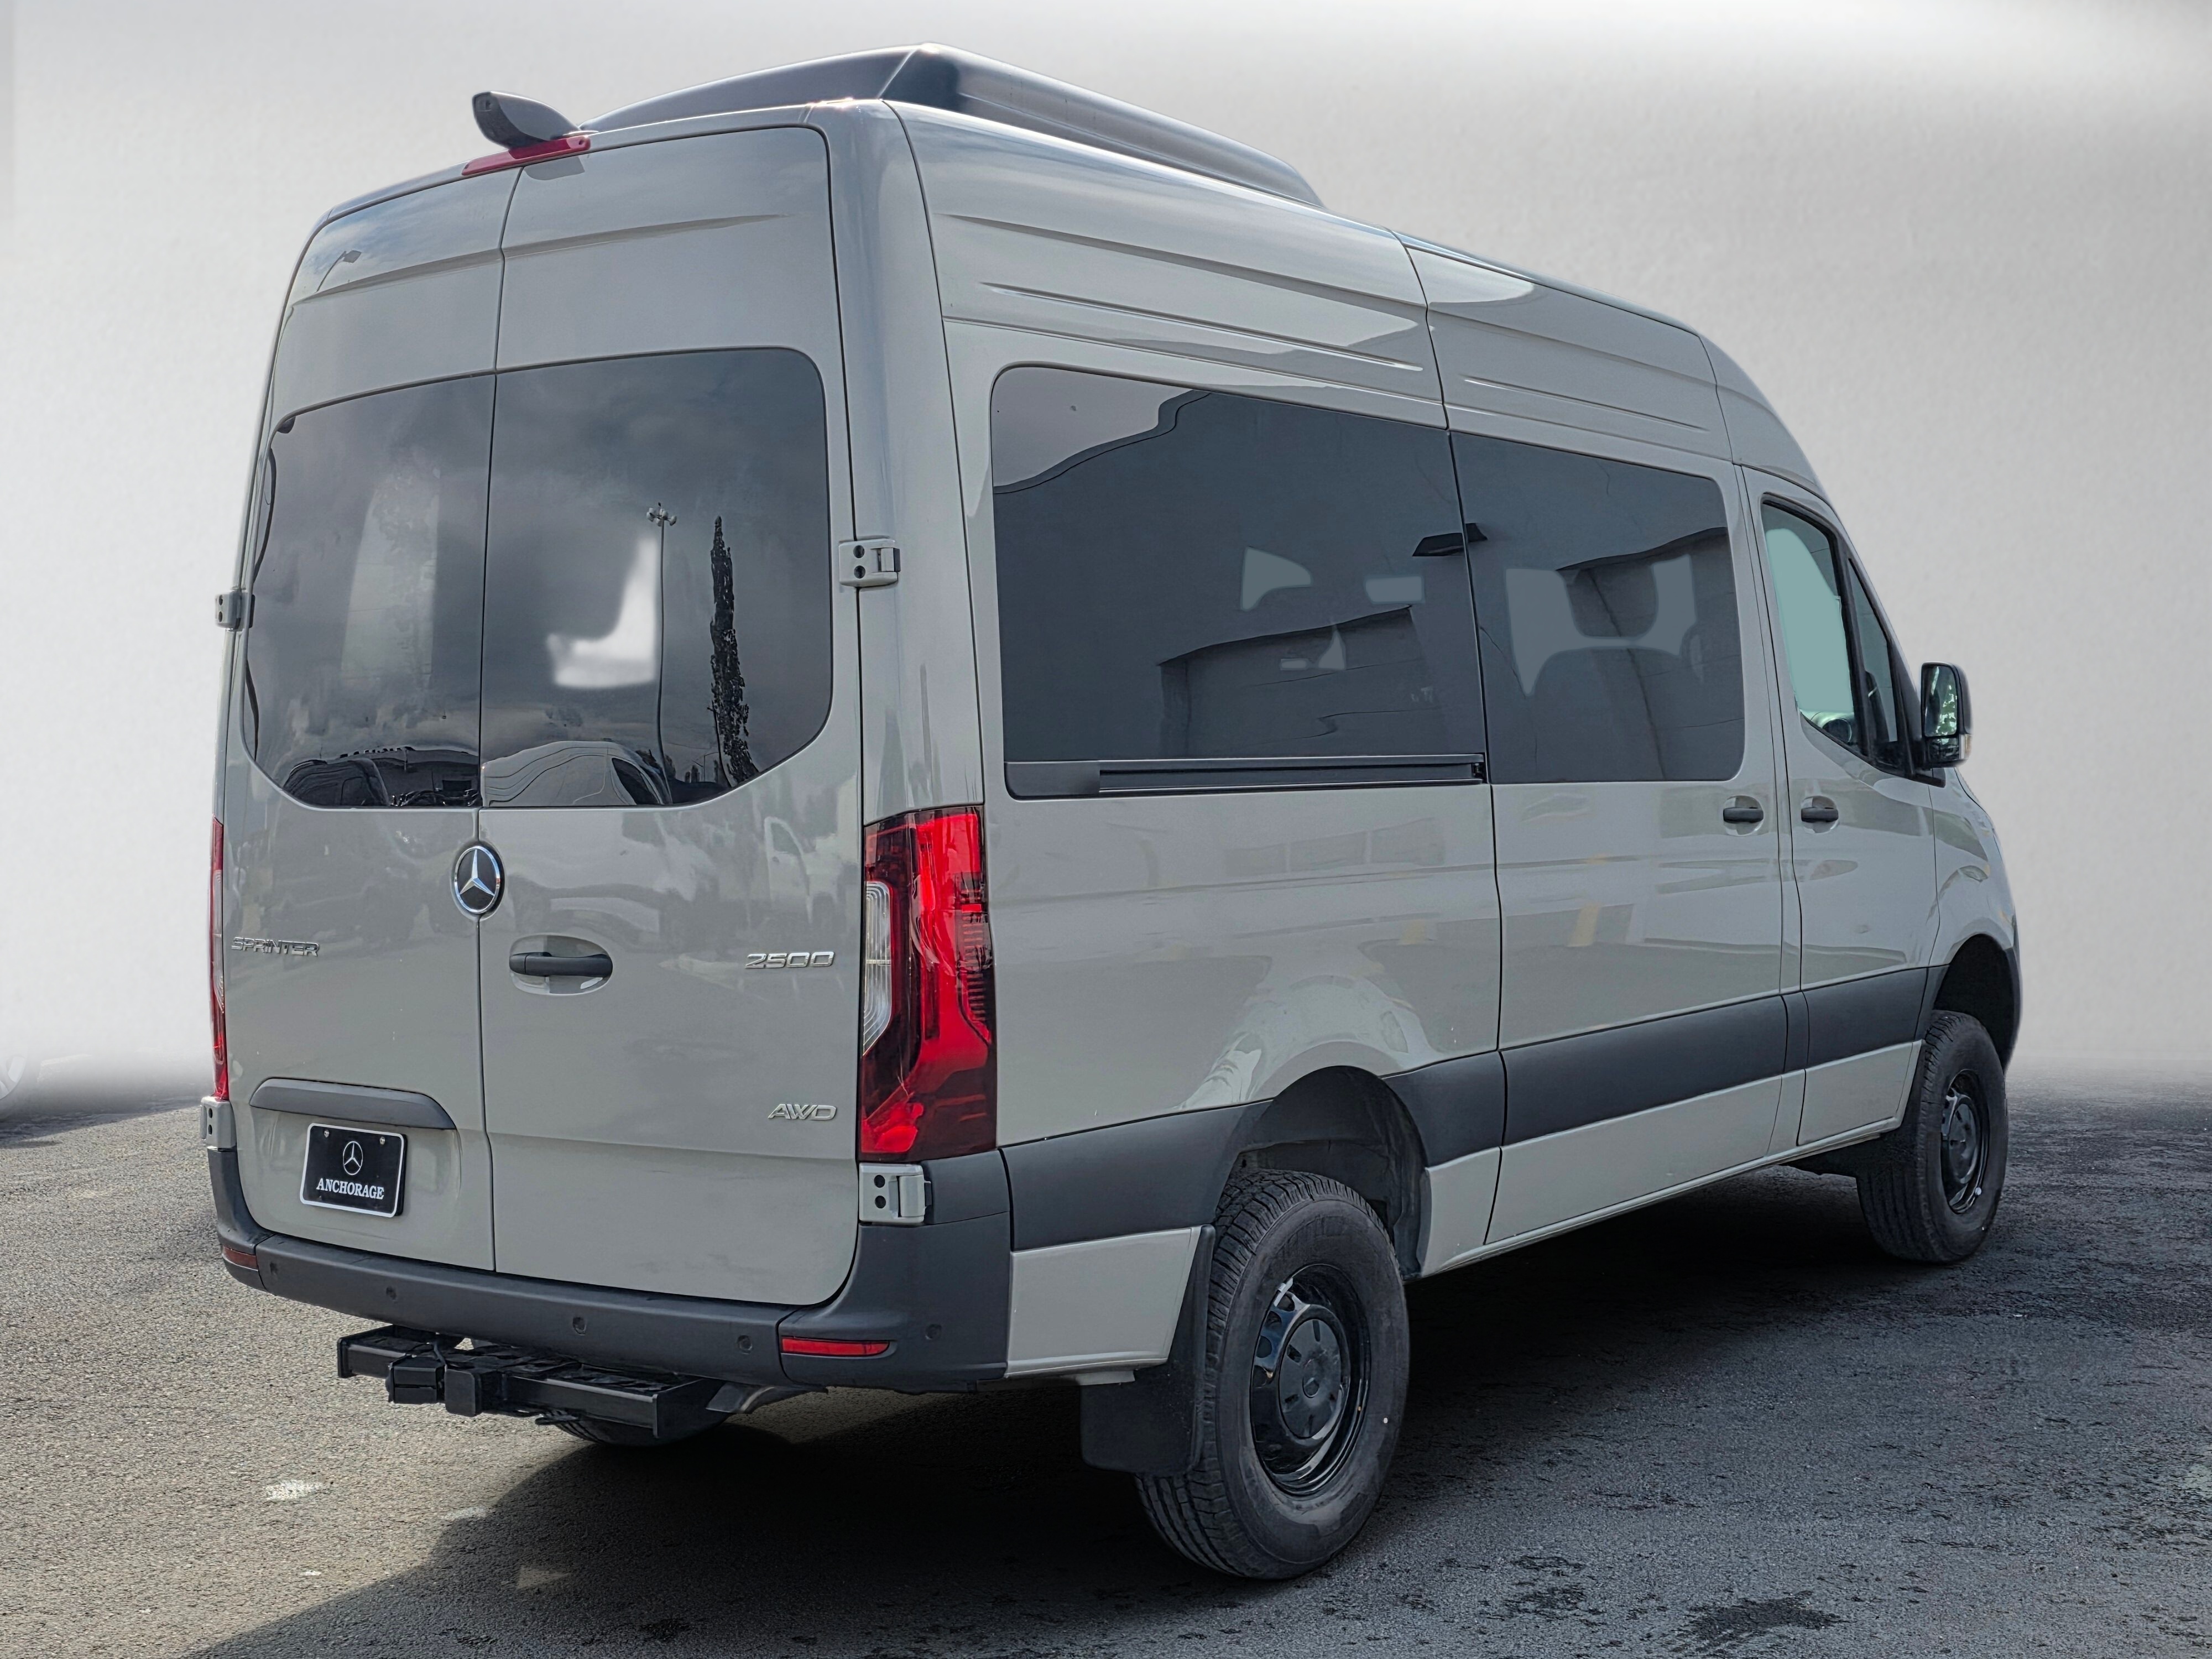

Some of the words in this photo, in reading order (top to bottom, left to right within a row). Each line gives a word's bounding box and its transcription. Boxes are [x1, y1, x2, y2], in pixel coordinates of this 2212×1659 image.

[231, 937, 319, 956] SPRINTER
[745, 951, 834, 968] 2500
[768, 1104, 837, 1120] AWD
[316, 1178, 384, 1199] ANCHORAGE
